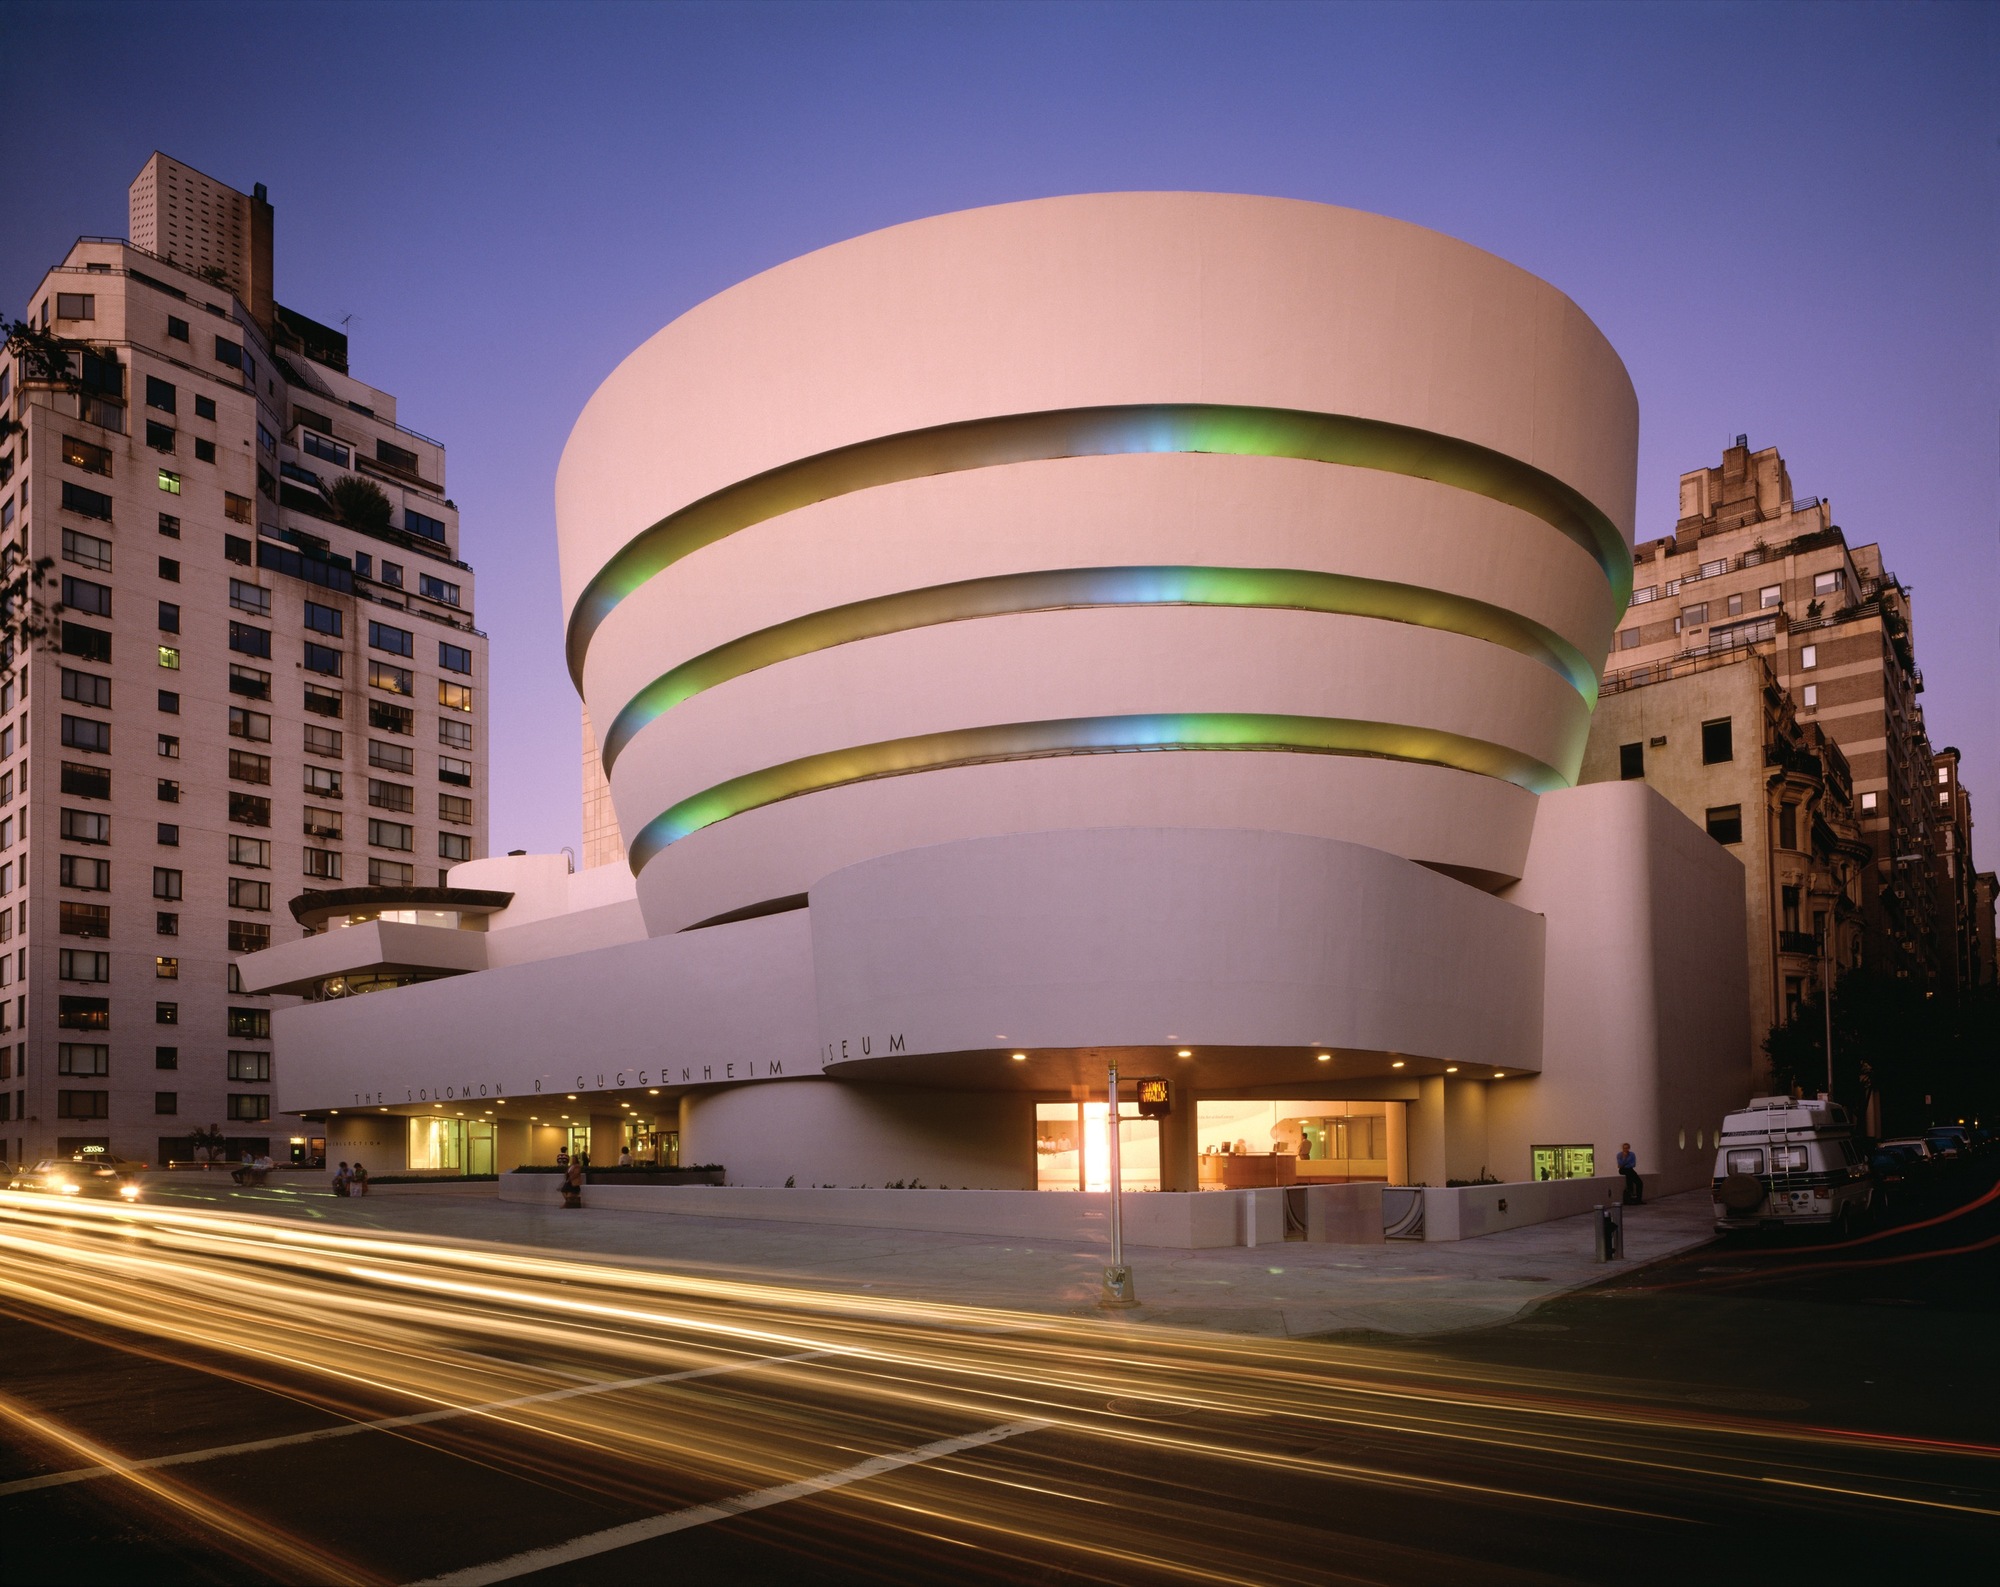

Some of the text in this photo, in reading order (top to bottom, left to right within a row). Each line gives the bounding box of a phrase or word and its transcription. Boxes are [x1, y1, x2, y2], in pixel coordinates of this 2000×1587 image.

[354, 1091, 383, 1105] THE
[407, 1083, 502, 1102] SOLOMON
[576, 1060, 783, 1089] GUGGENHEIM
